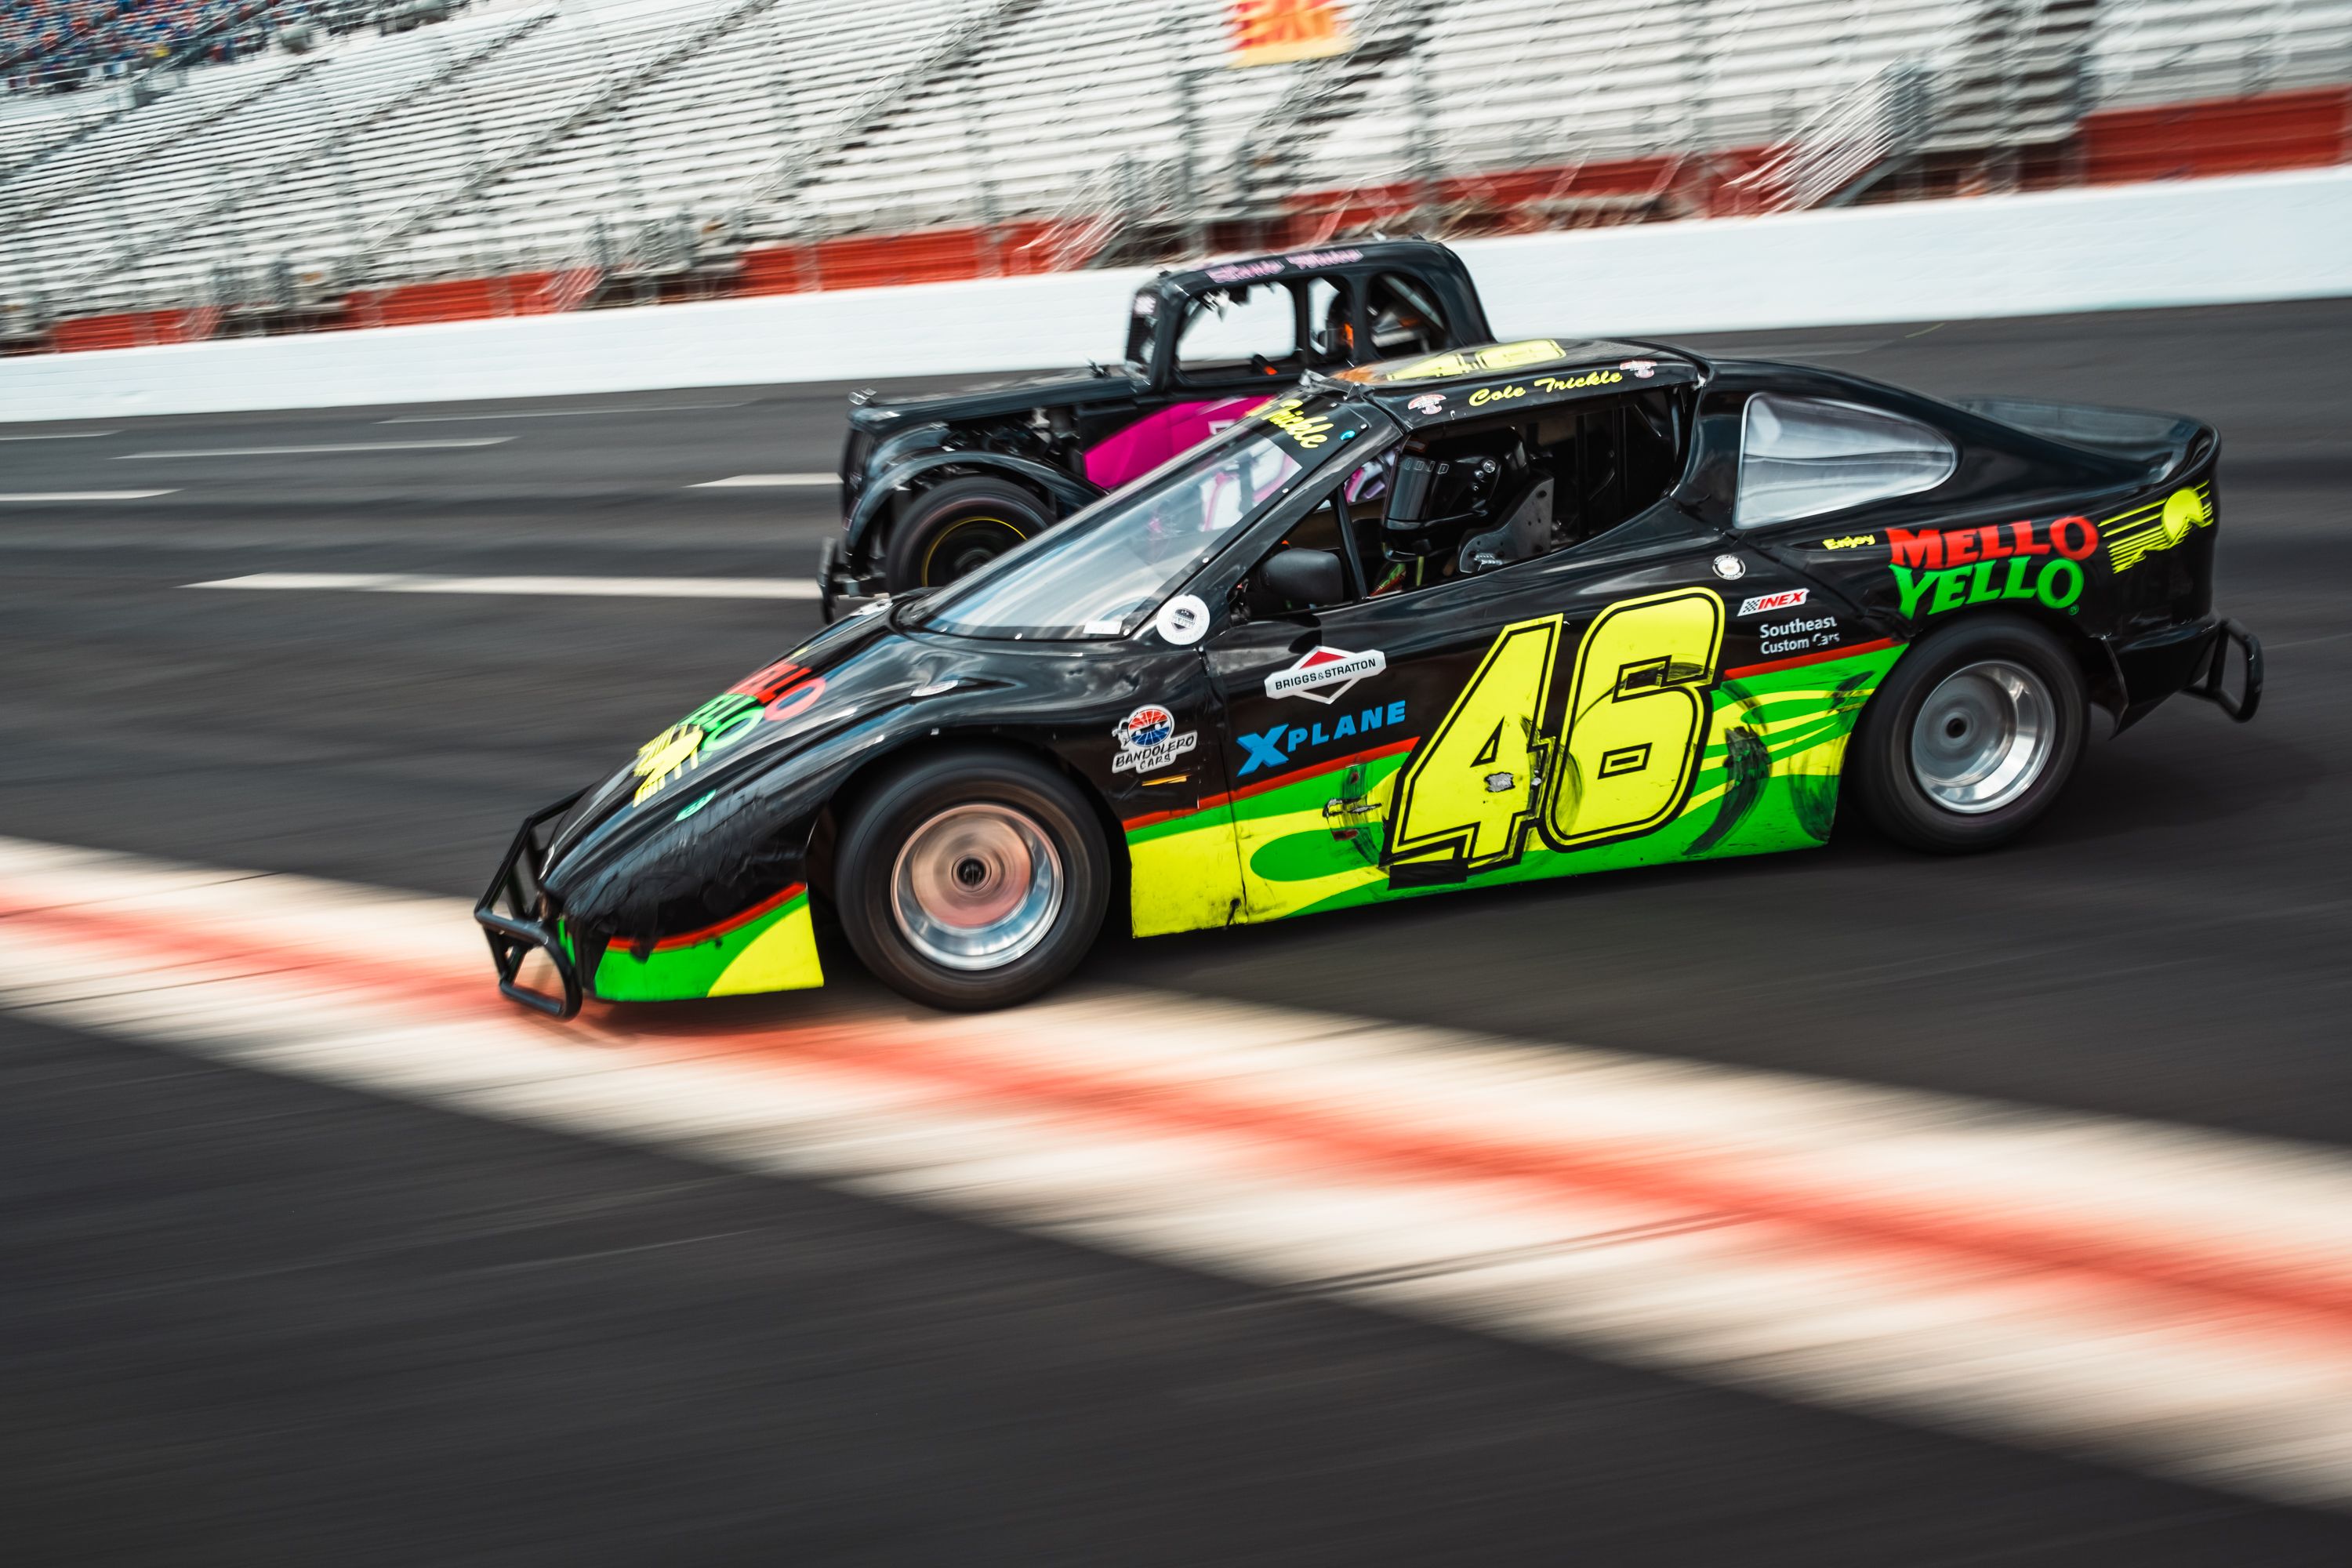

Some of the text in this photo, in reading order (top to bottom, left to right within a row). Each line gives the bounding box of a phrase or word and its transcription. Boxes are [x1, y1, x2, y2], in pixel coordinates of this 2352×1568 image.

[1468, 384, 1527, 408] Cole
[1534, 370, 1623, 394] Trickle
[1822, 534, 1876, 550] Enjoy
[1885, 515, 2100, 570] MELLO
[1758, 591, 1806, 611] INEX
[1888, 556, 2085, 621] YELLO
[1759, 615, 1838, 639] Southeast
[1759, 637, 1809, 655] Custom
[1386, 586, 1726, 870] 46
[1115, 735, 1195, 768] BANDOLERO
[1139, 753, 1171, 771] CARS
